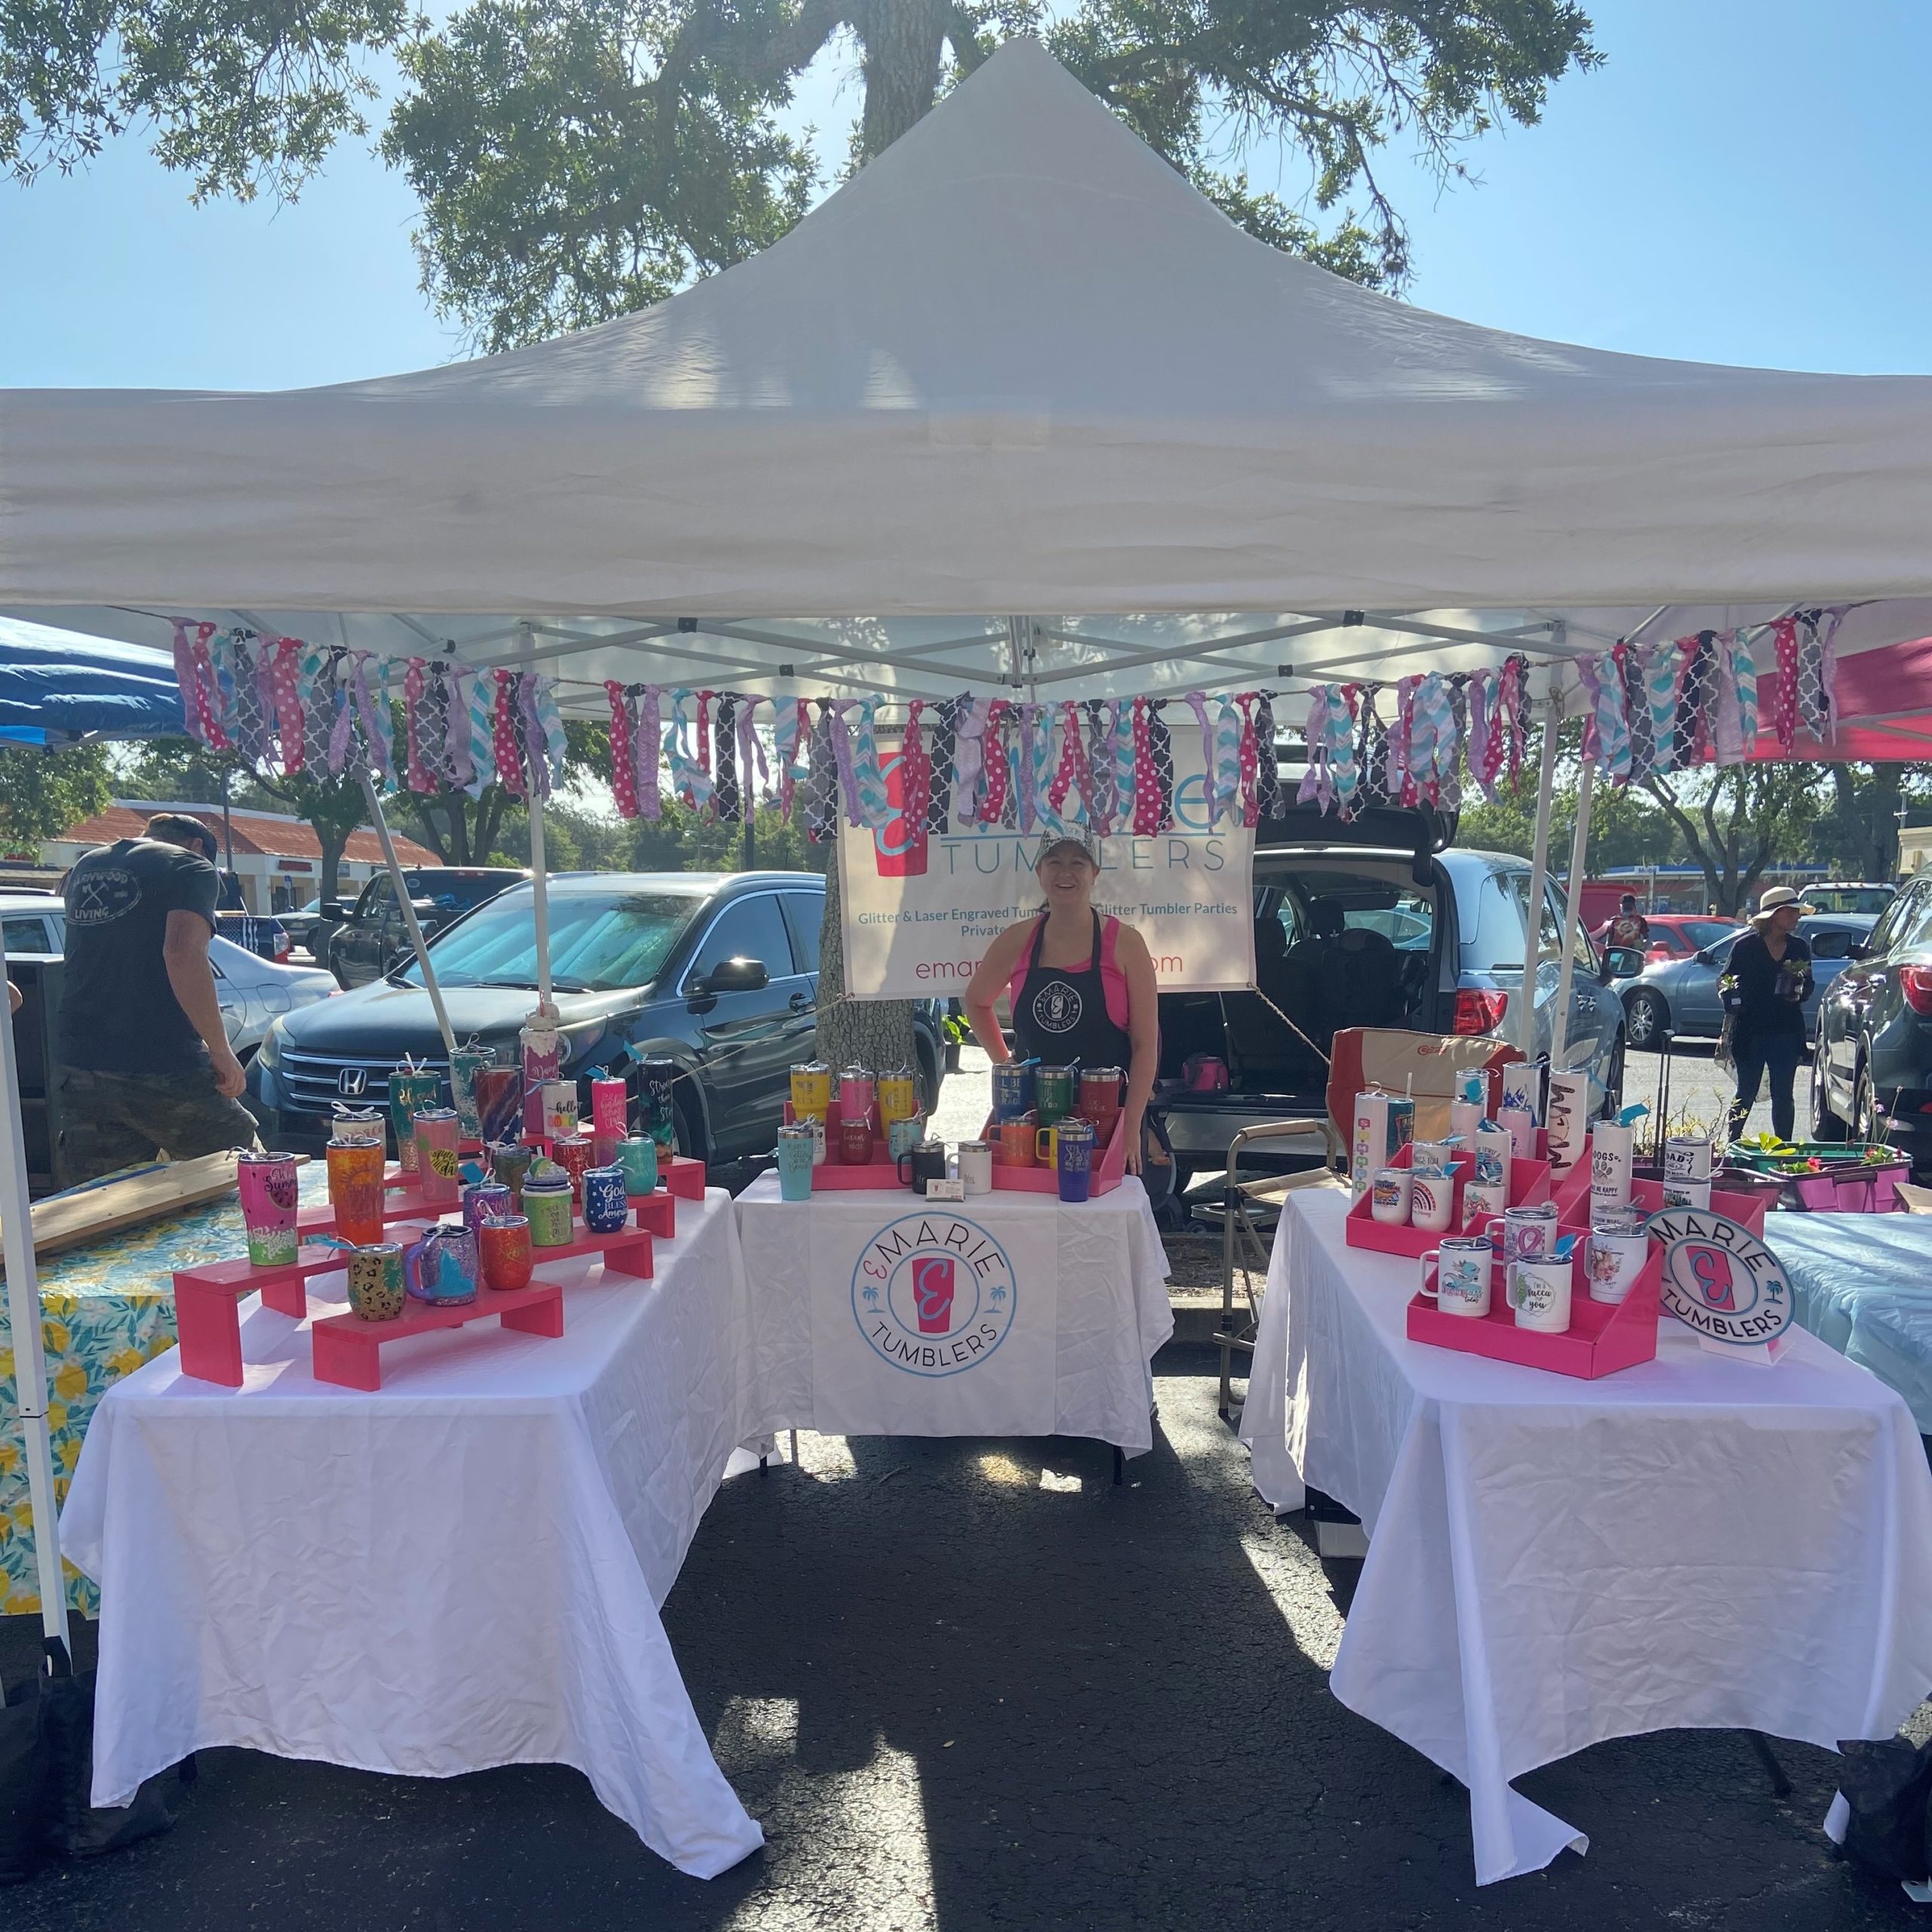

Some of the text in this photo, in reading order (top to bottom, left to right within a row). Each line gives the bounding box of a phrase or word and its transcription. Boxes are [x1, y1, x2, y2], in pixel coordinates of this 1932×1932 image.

[940, 839, 1225, 875] TUMLERS
[75, 906, 109, 919] LIVING
[858, 912, 900, 924] Glitter
[903, 910, 912, 922] &
[915, 910, 949, 922] Laser
[952, 907, 1010, 923] Engraved
[1140, 903, 1191, 915] Tumbler
[1195, 902, 1238, 915] Parties
[961, 924, 1006, 937] Private
[1038, 1014, 1075, 1029] TUMBLERS
[598, 1183, 625, 1203] God
[1649, 1215, 1777, 1273] MARIE
[1528, 1301, 1547, 1311] you
[1663, 1288, 1782, 1337] TUMBLERS
[872, 1321, 997, 1367] TUMBLERS
